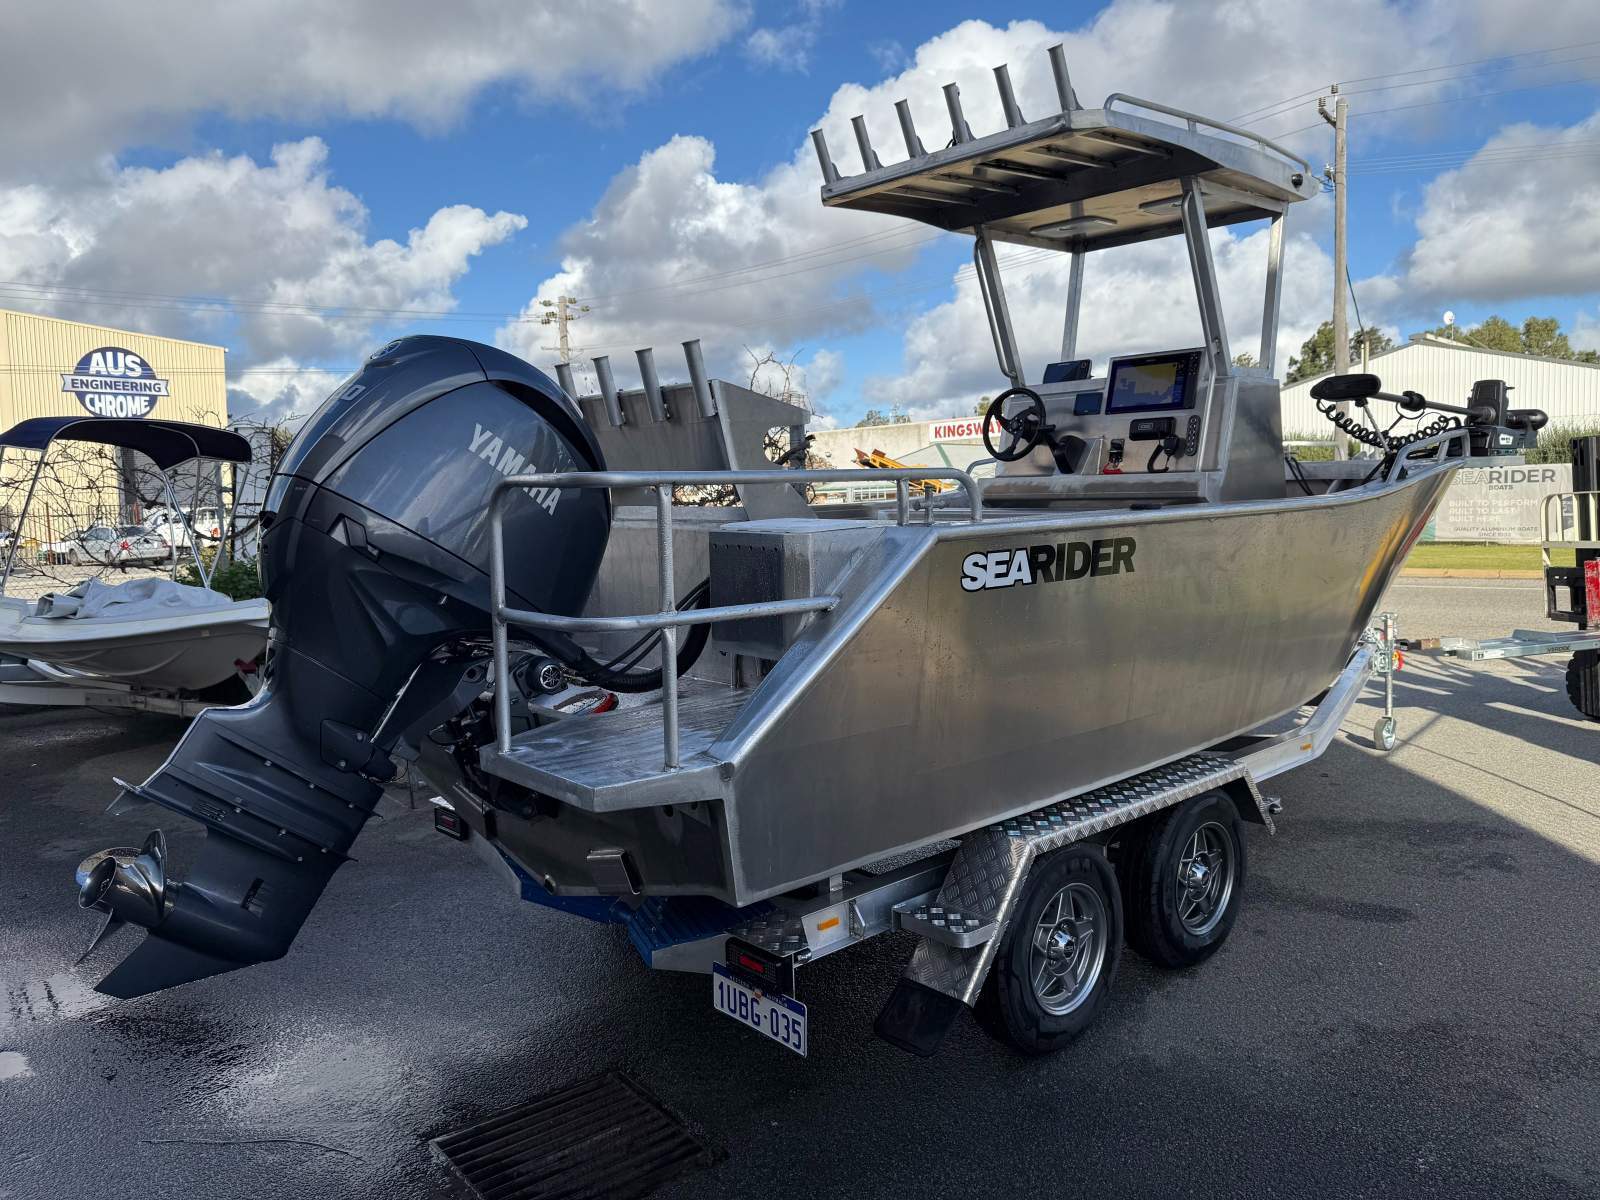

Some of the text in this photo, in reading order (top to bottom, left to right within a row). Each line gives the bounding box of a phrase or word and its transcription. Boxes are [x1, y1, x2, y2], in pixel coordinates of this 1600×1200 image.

[88, 351, 142, 377] AUS
[71, 378, 161, 392] ENGINEERING
[84, 394, 150, 417] CHROME
[961, 536, 1137, 593] SEARIDER
